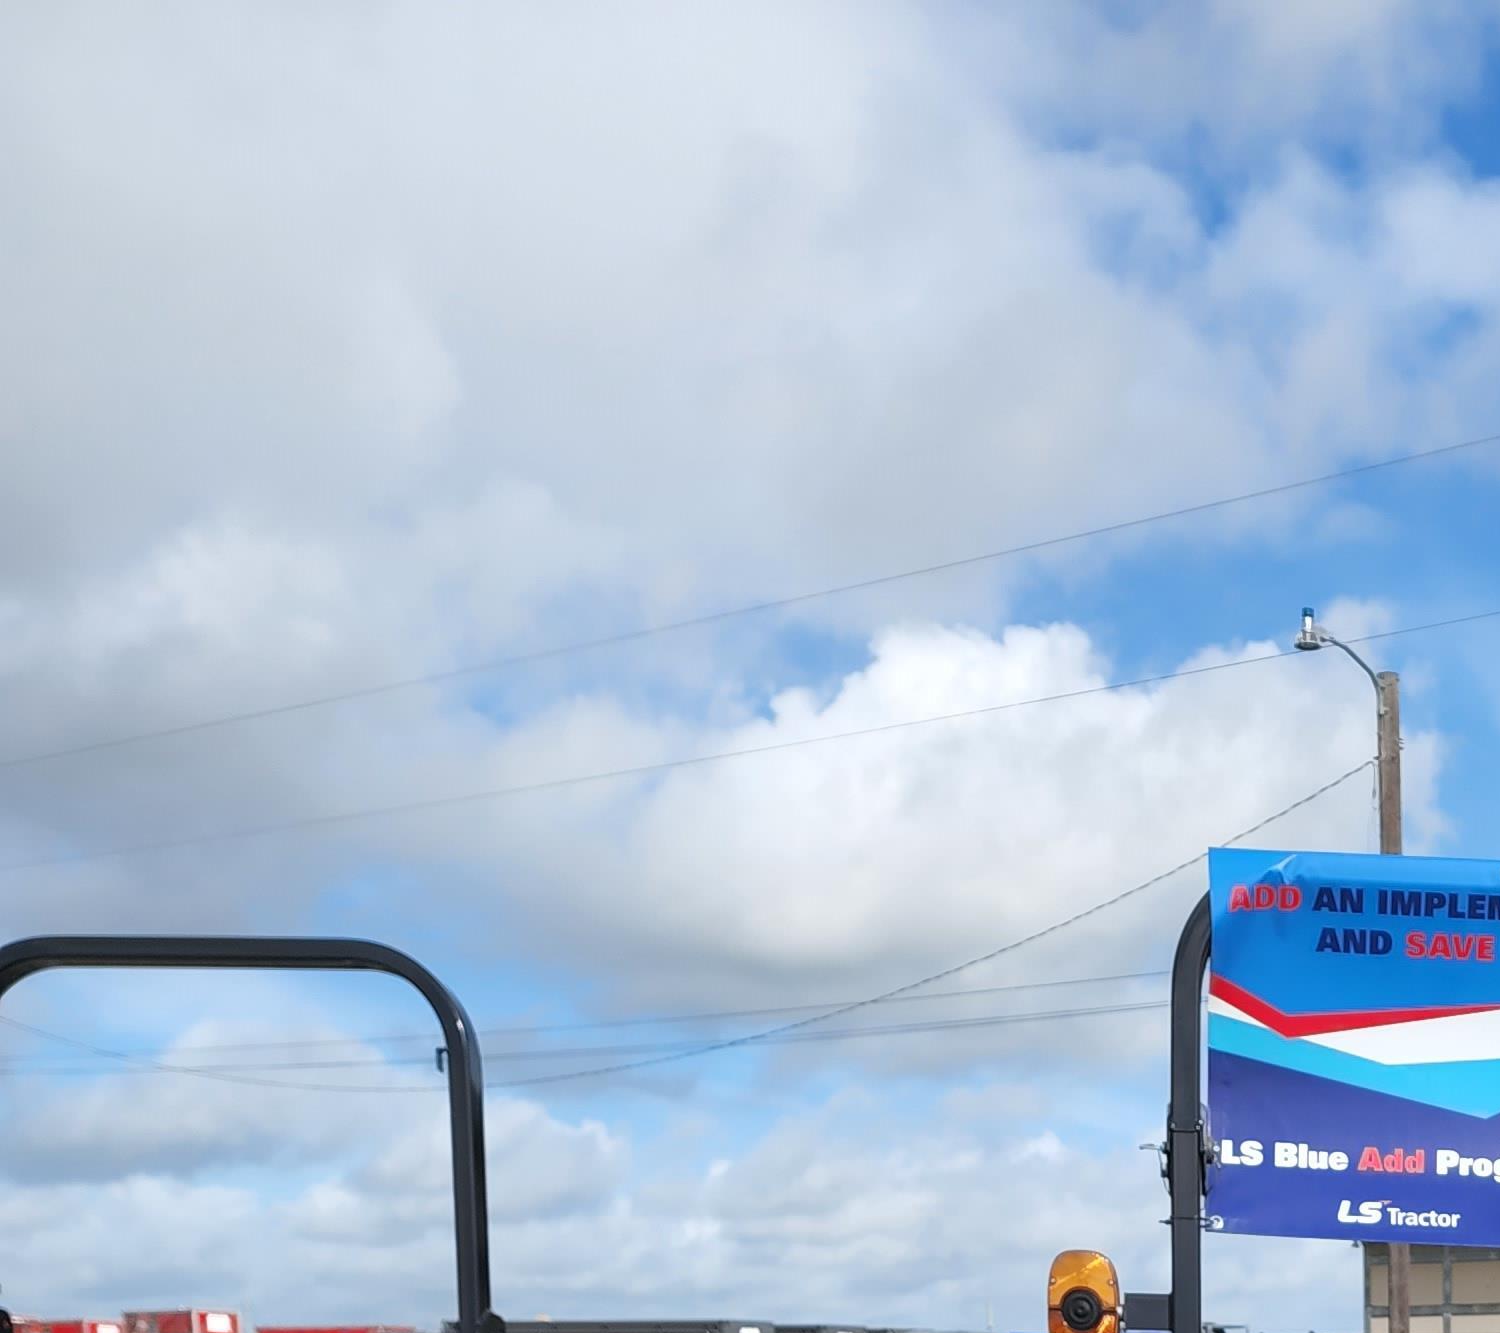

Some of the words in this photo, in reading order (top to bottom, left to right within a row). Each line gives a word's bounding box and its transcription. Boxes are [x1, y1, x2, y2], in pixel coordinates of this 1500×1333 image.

[1229, 885, 1302, 912] ADD
[1313, 887, 1363, 914] AN
[1316, 928, 1392, 955] AND
[1405, 932, 1496, 961] SAVE
[1220, 1139, 1263, 1166] LS
[1274, 1142, 1348, 1171] Blue
[1357, 1147, 1425, 1175] Add
[1337, 1199, 1386, 1224] LS
[1388, 1206, 1460, 1228] Tractor
